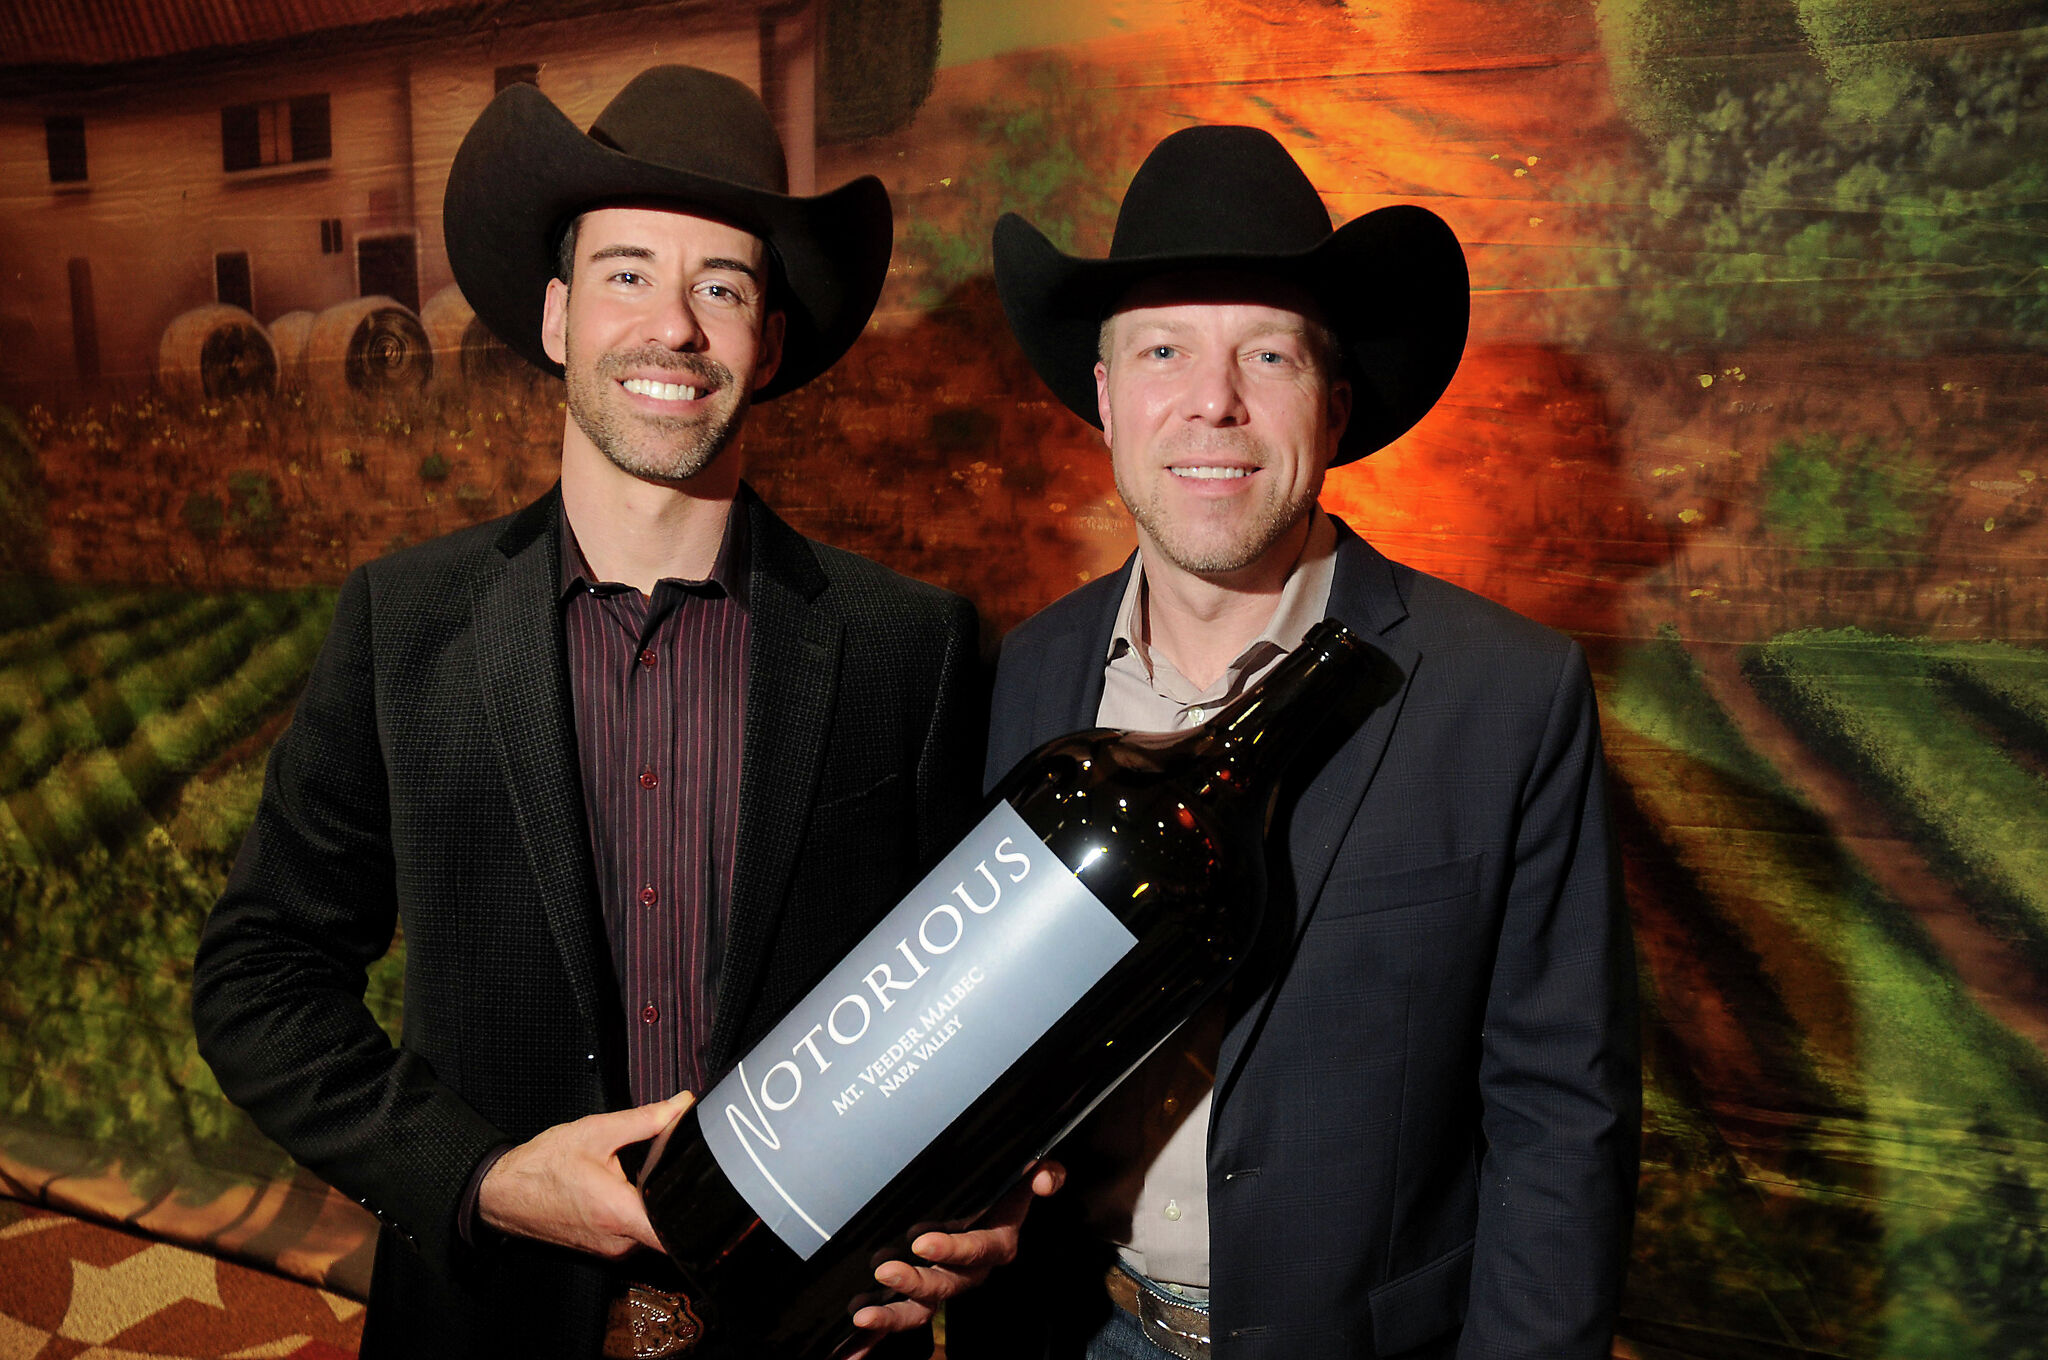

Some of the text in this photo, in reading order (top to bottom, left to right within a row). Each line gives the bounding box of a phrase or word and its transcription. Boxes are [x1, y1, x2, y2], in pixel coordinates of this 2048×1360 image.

[725, 836, 1032, 1241] NOTORIOUS
[831, 966, 985, 1116] MT. VEEDER MALBEC
[878, 1014, 963, 1098] NAPA VALLEY
